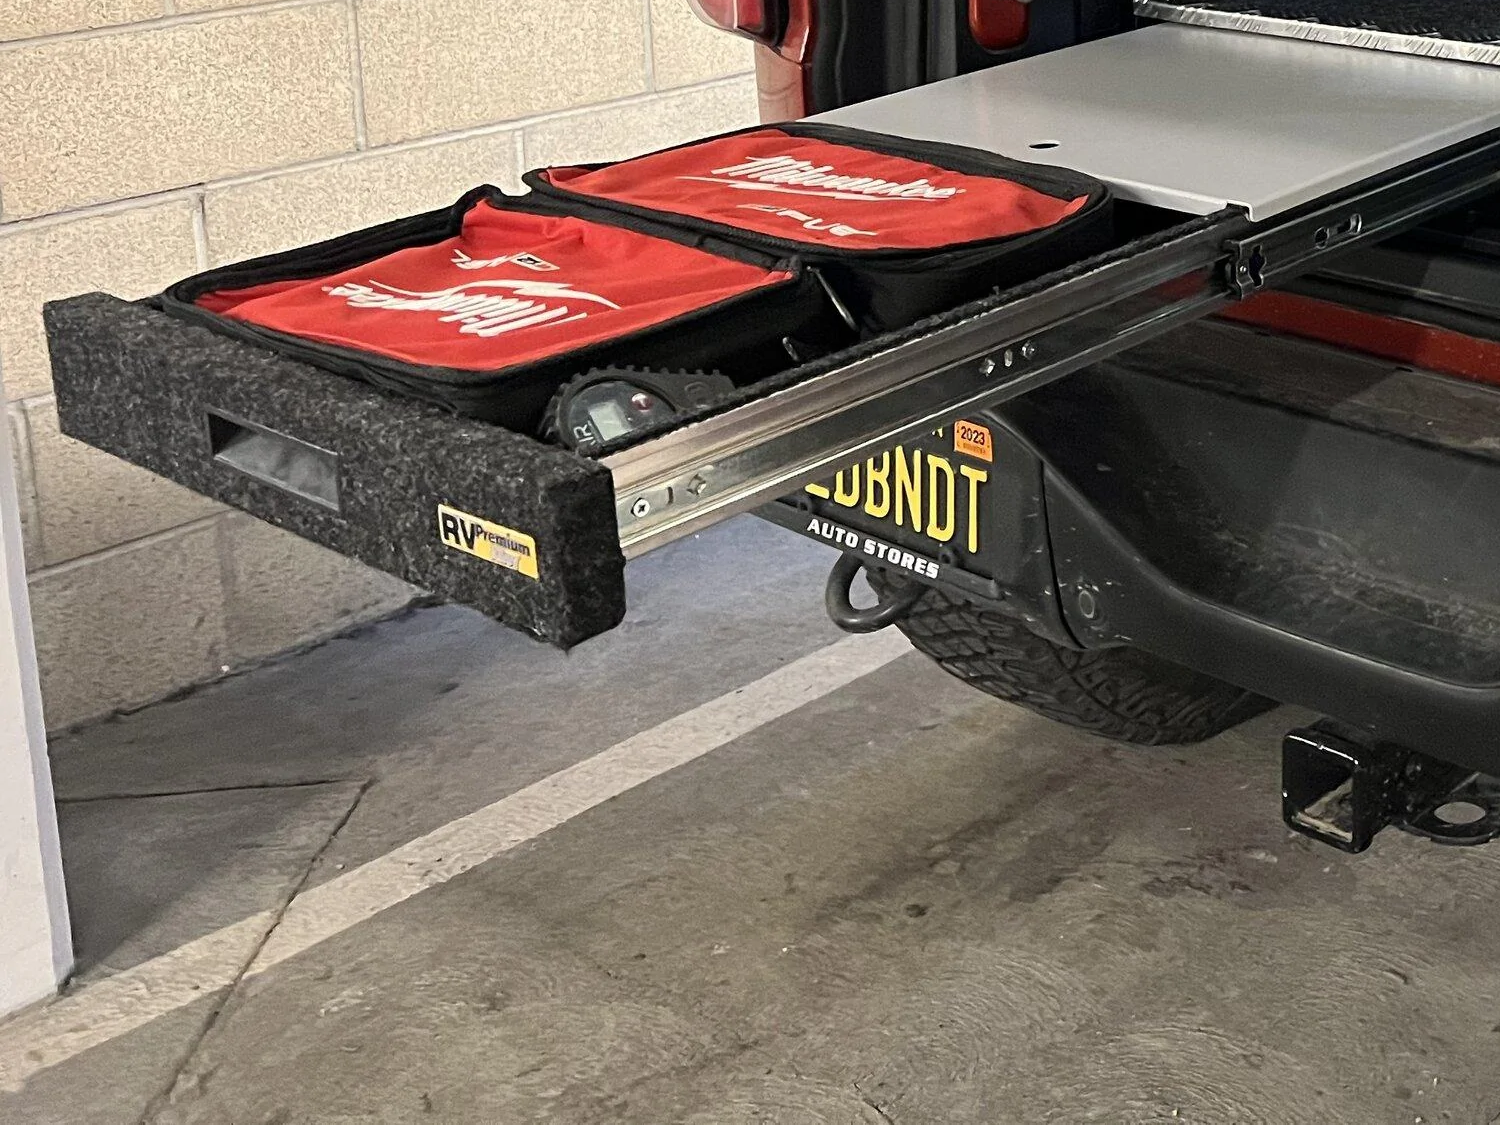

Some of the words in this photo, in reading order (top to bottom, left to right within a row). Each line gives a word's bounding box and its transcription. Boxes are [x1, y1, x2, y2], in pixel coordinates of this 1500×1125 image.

[961, 425, 985, 446] 2023
[441, 512, 476, 550] RV
[474, 524, 531, 557] Premium
[806, 518, 859, 549] AUTO
[863, 537, 940, 579] STORES
